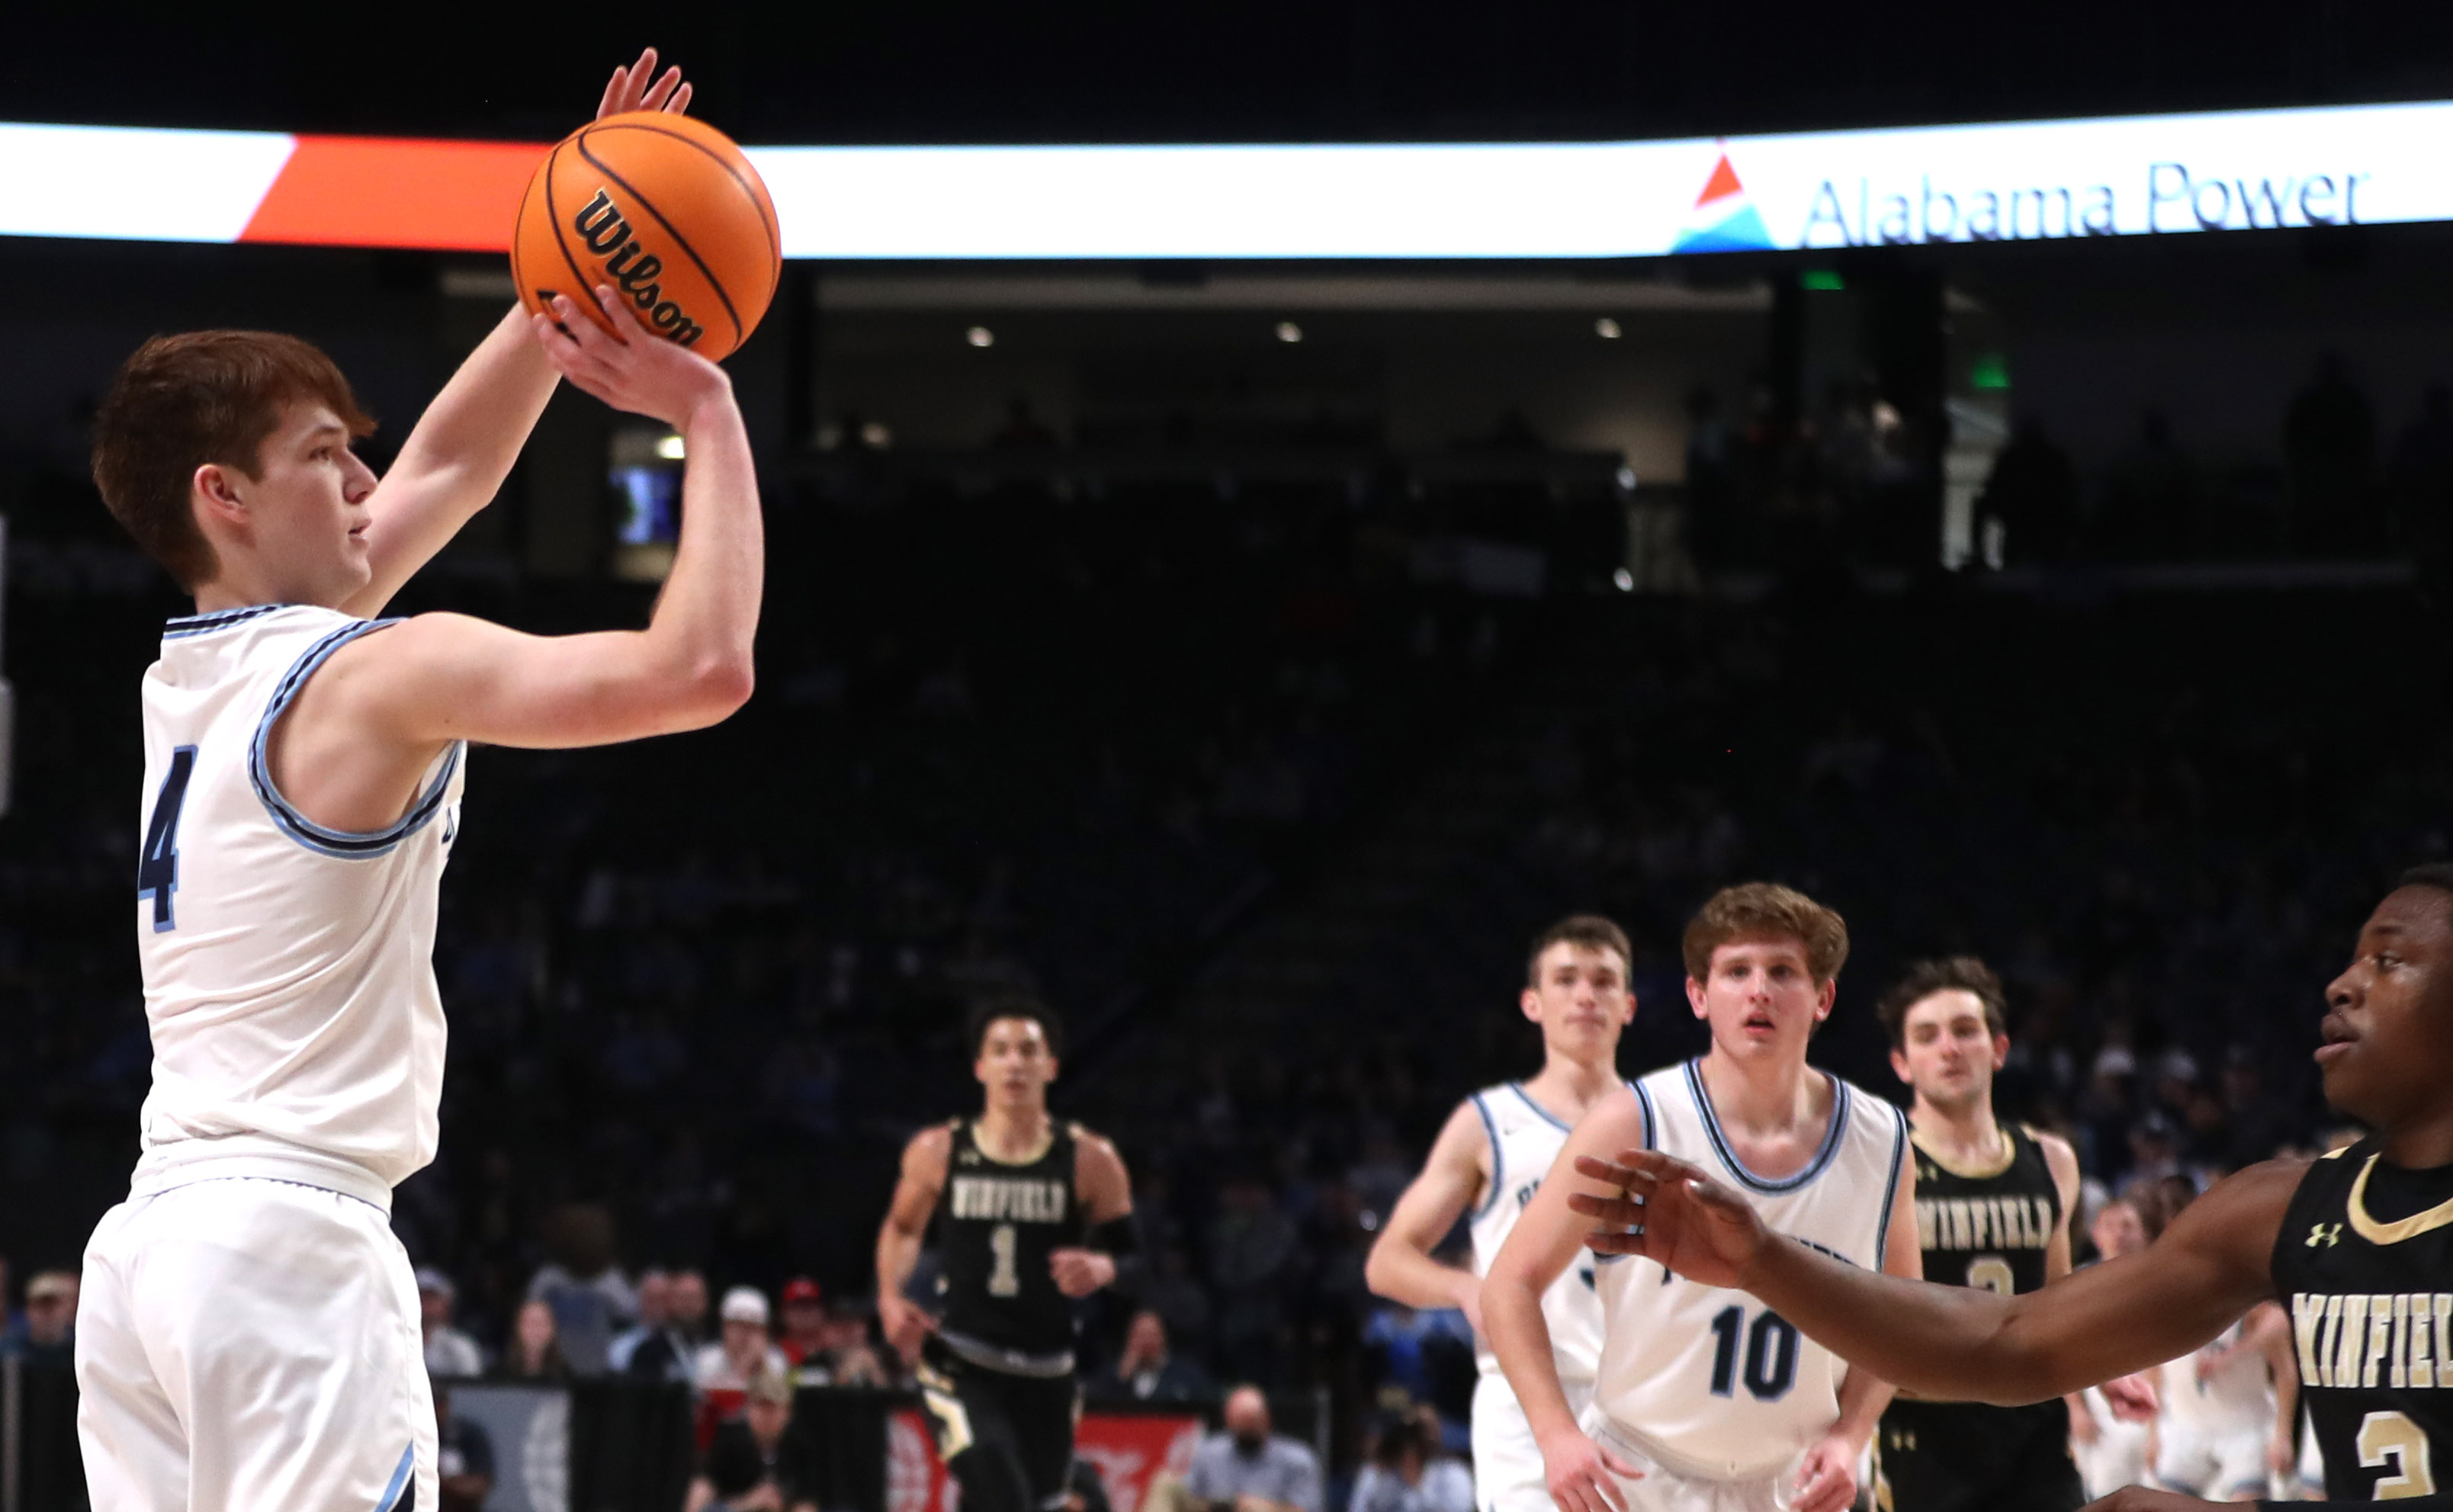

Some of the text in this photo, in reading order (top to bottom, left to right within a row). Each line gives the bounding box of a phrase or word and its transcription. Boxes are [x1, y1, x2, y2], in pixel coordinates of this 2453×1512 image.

[1800, 161, 2371, 249] Alabama Power
[575, 188, 704, 346] Wilson
[138, 744, 199, 934] 4
[987, 1225, 1019, 1297] 1
[1710, 1305, 1803, 1403] 10
[2292, 1292, 2453, 1388] WINFIEL
